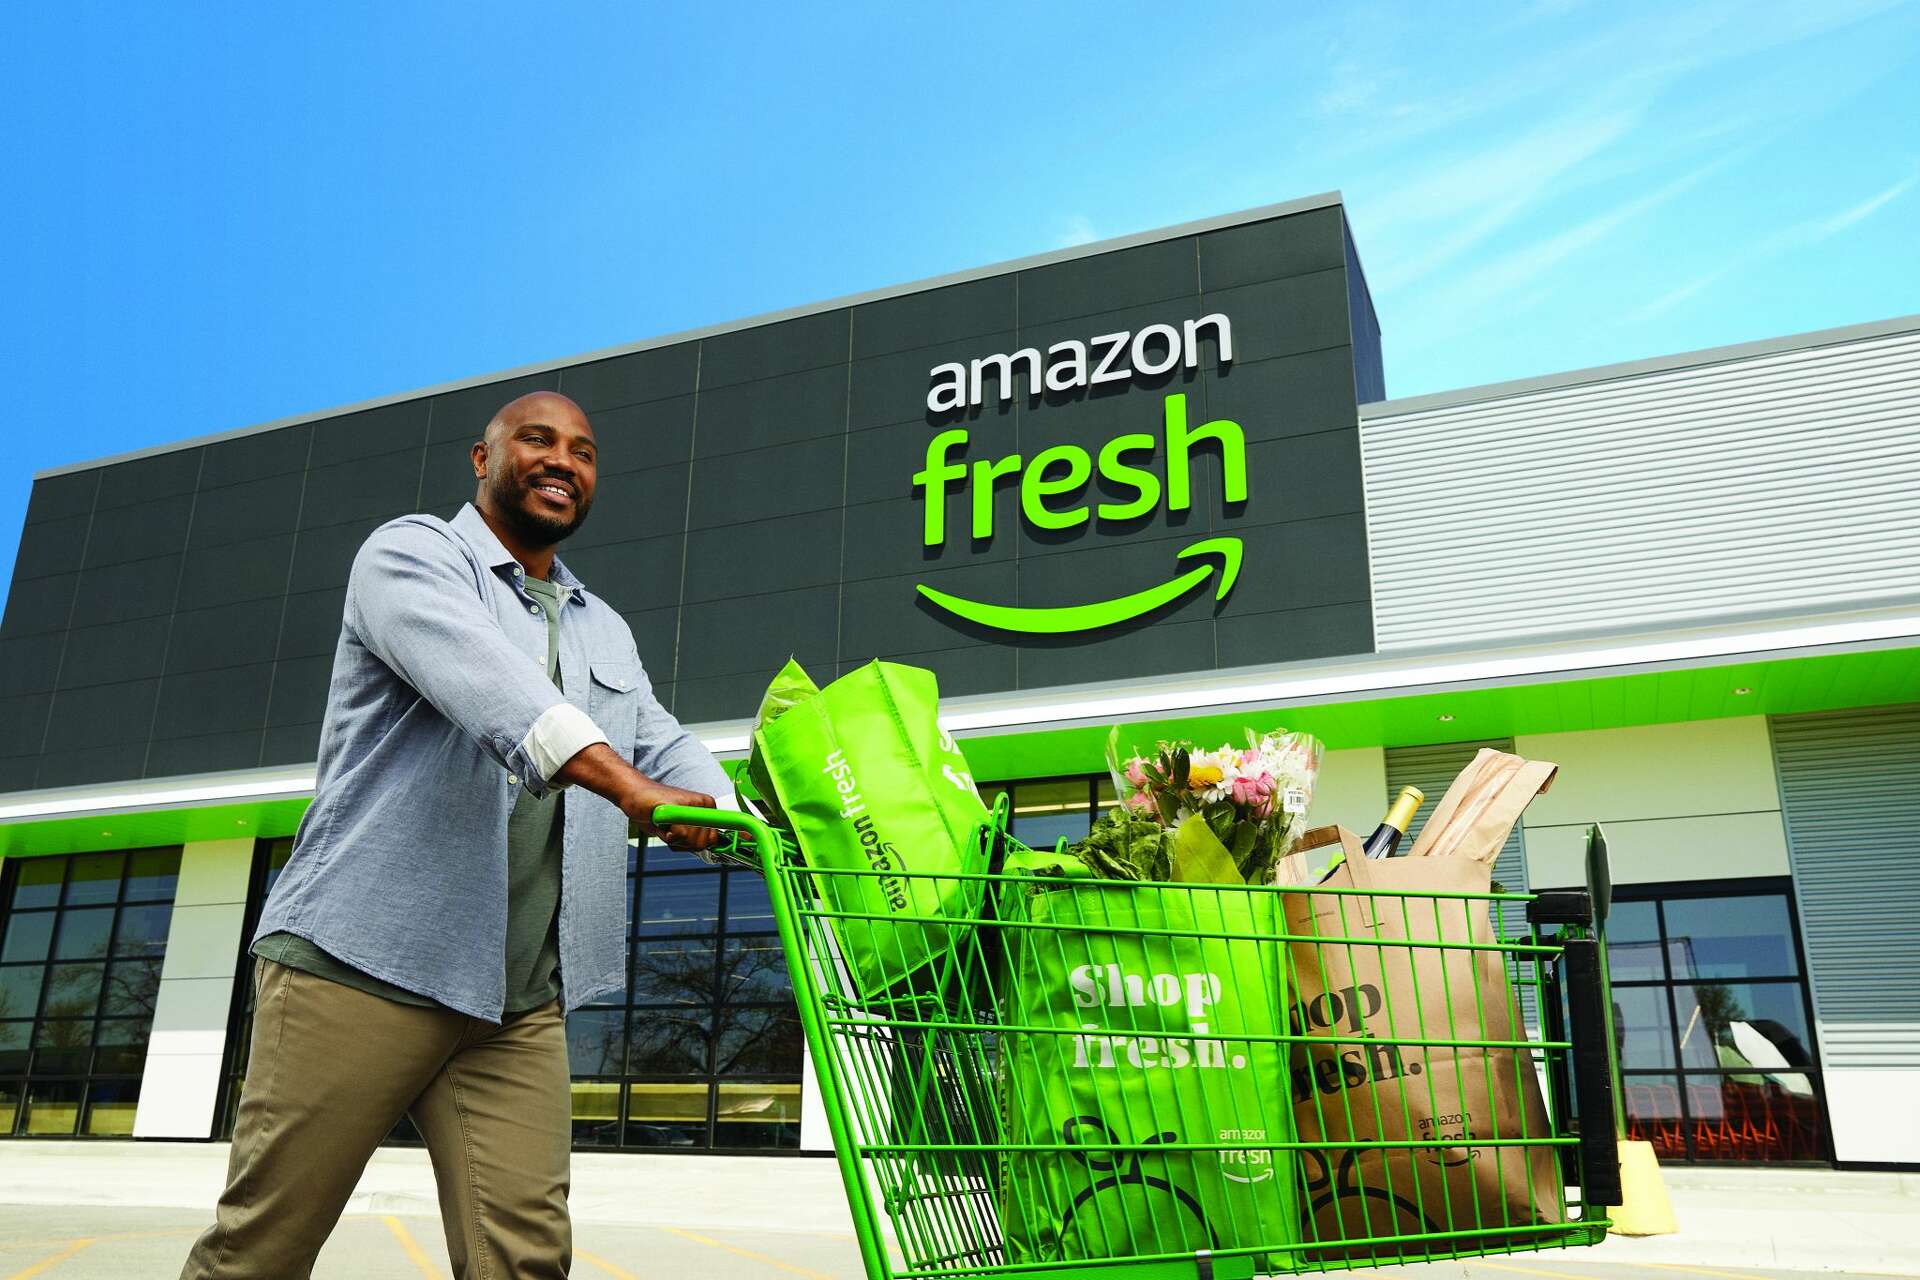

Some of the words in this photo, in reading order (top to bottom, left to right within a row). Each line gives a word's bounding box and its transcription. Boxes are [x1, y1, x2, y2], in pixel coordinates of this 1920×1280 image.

[927, 313, 1232, 412] amazon
[913, 393, 1247, 546] fresh
[822, 749, 865, 820] fresh
[853, 814, 907, 912] amazon
[1071, 963, 1221, 1017] Shop
[1072, 1023, 1246, 1069] fresh.
